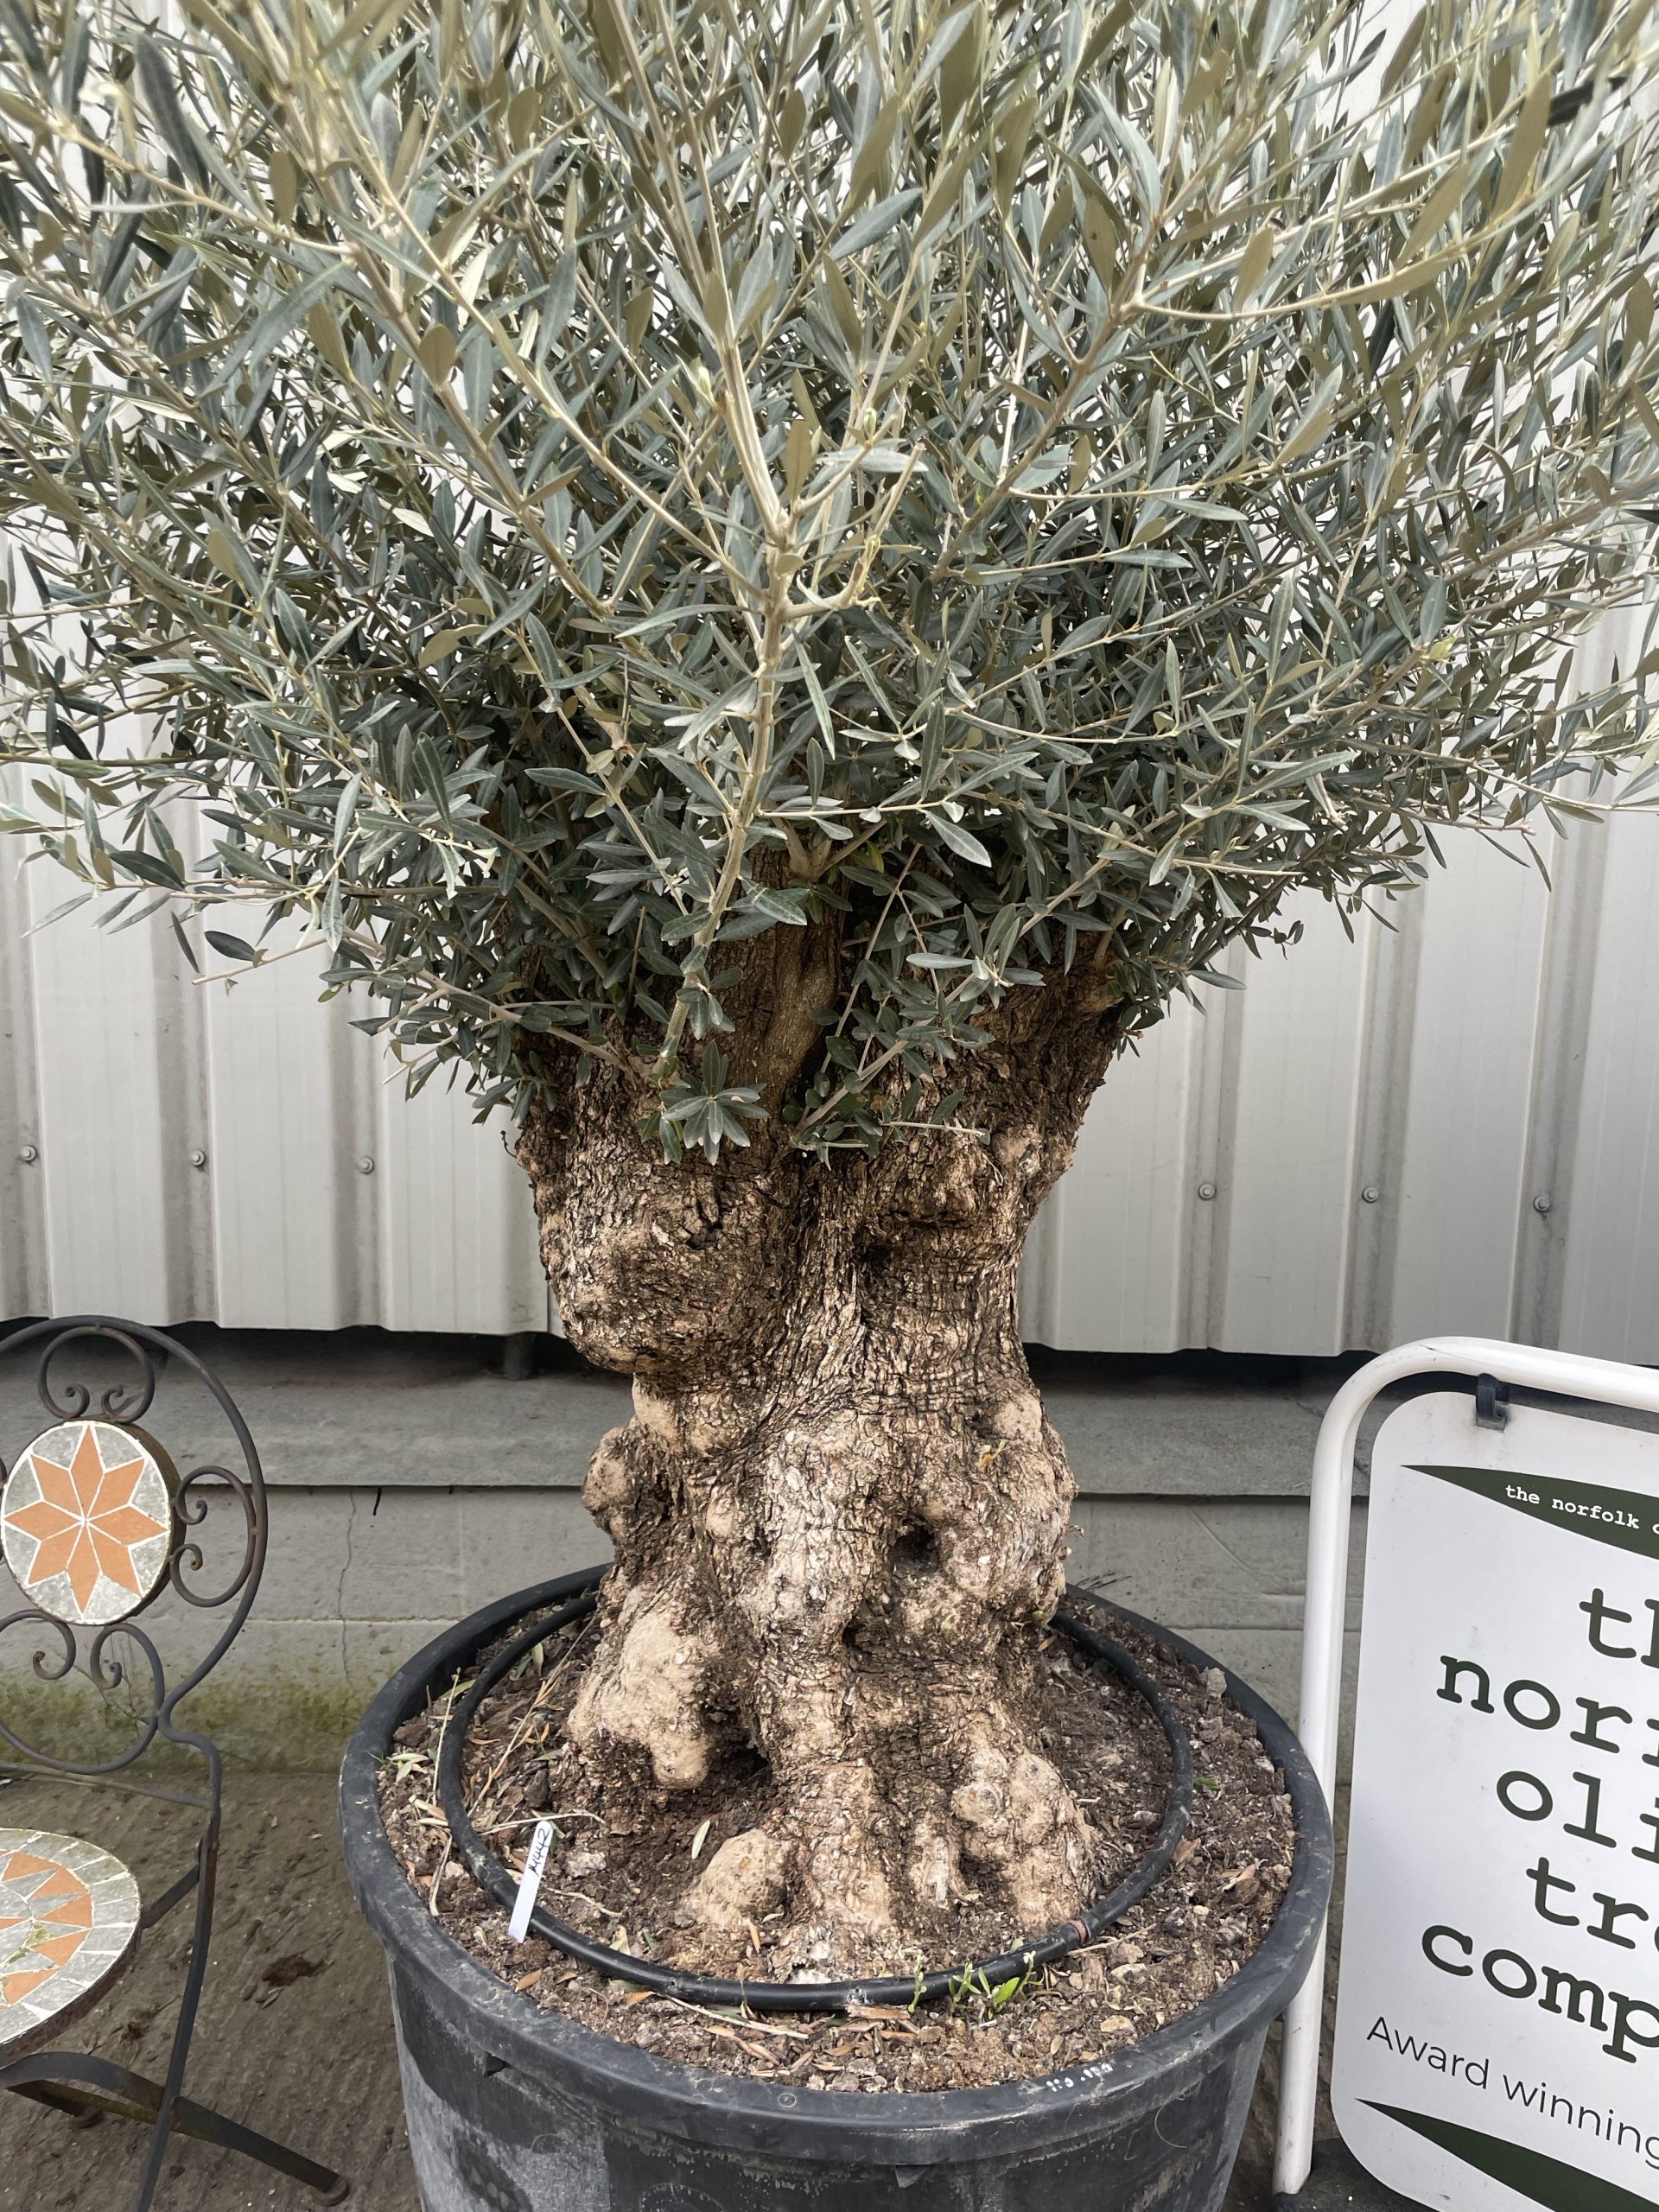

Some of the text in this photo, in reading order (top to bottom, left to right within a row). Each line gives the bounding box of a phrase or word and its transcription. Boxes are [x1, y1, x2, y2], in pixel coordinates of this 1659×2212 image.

[1504, 1484, 1541, 1505] the
[1552, 1496, 1640, 1529] norfolk
[1526, 1857, 1659, 1949] tr
[1421, 1924, 1659, 2063] comp
[1366, 2016, 1489, 2089] Award
